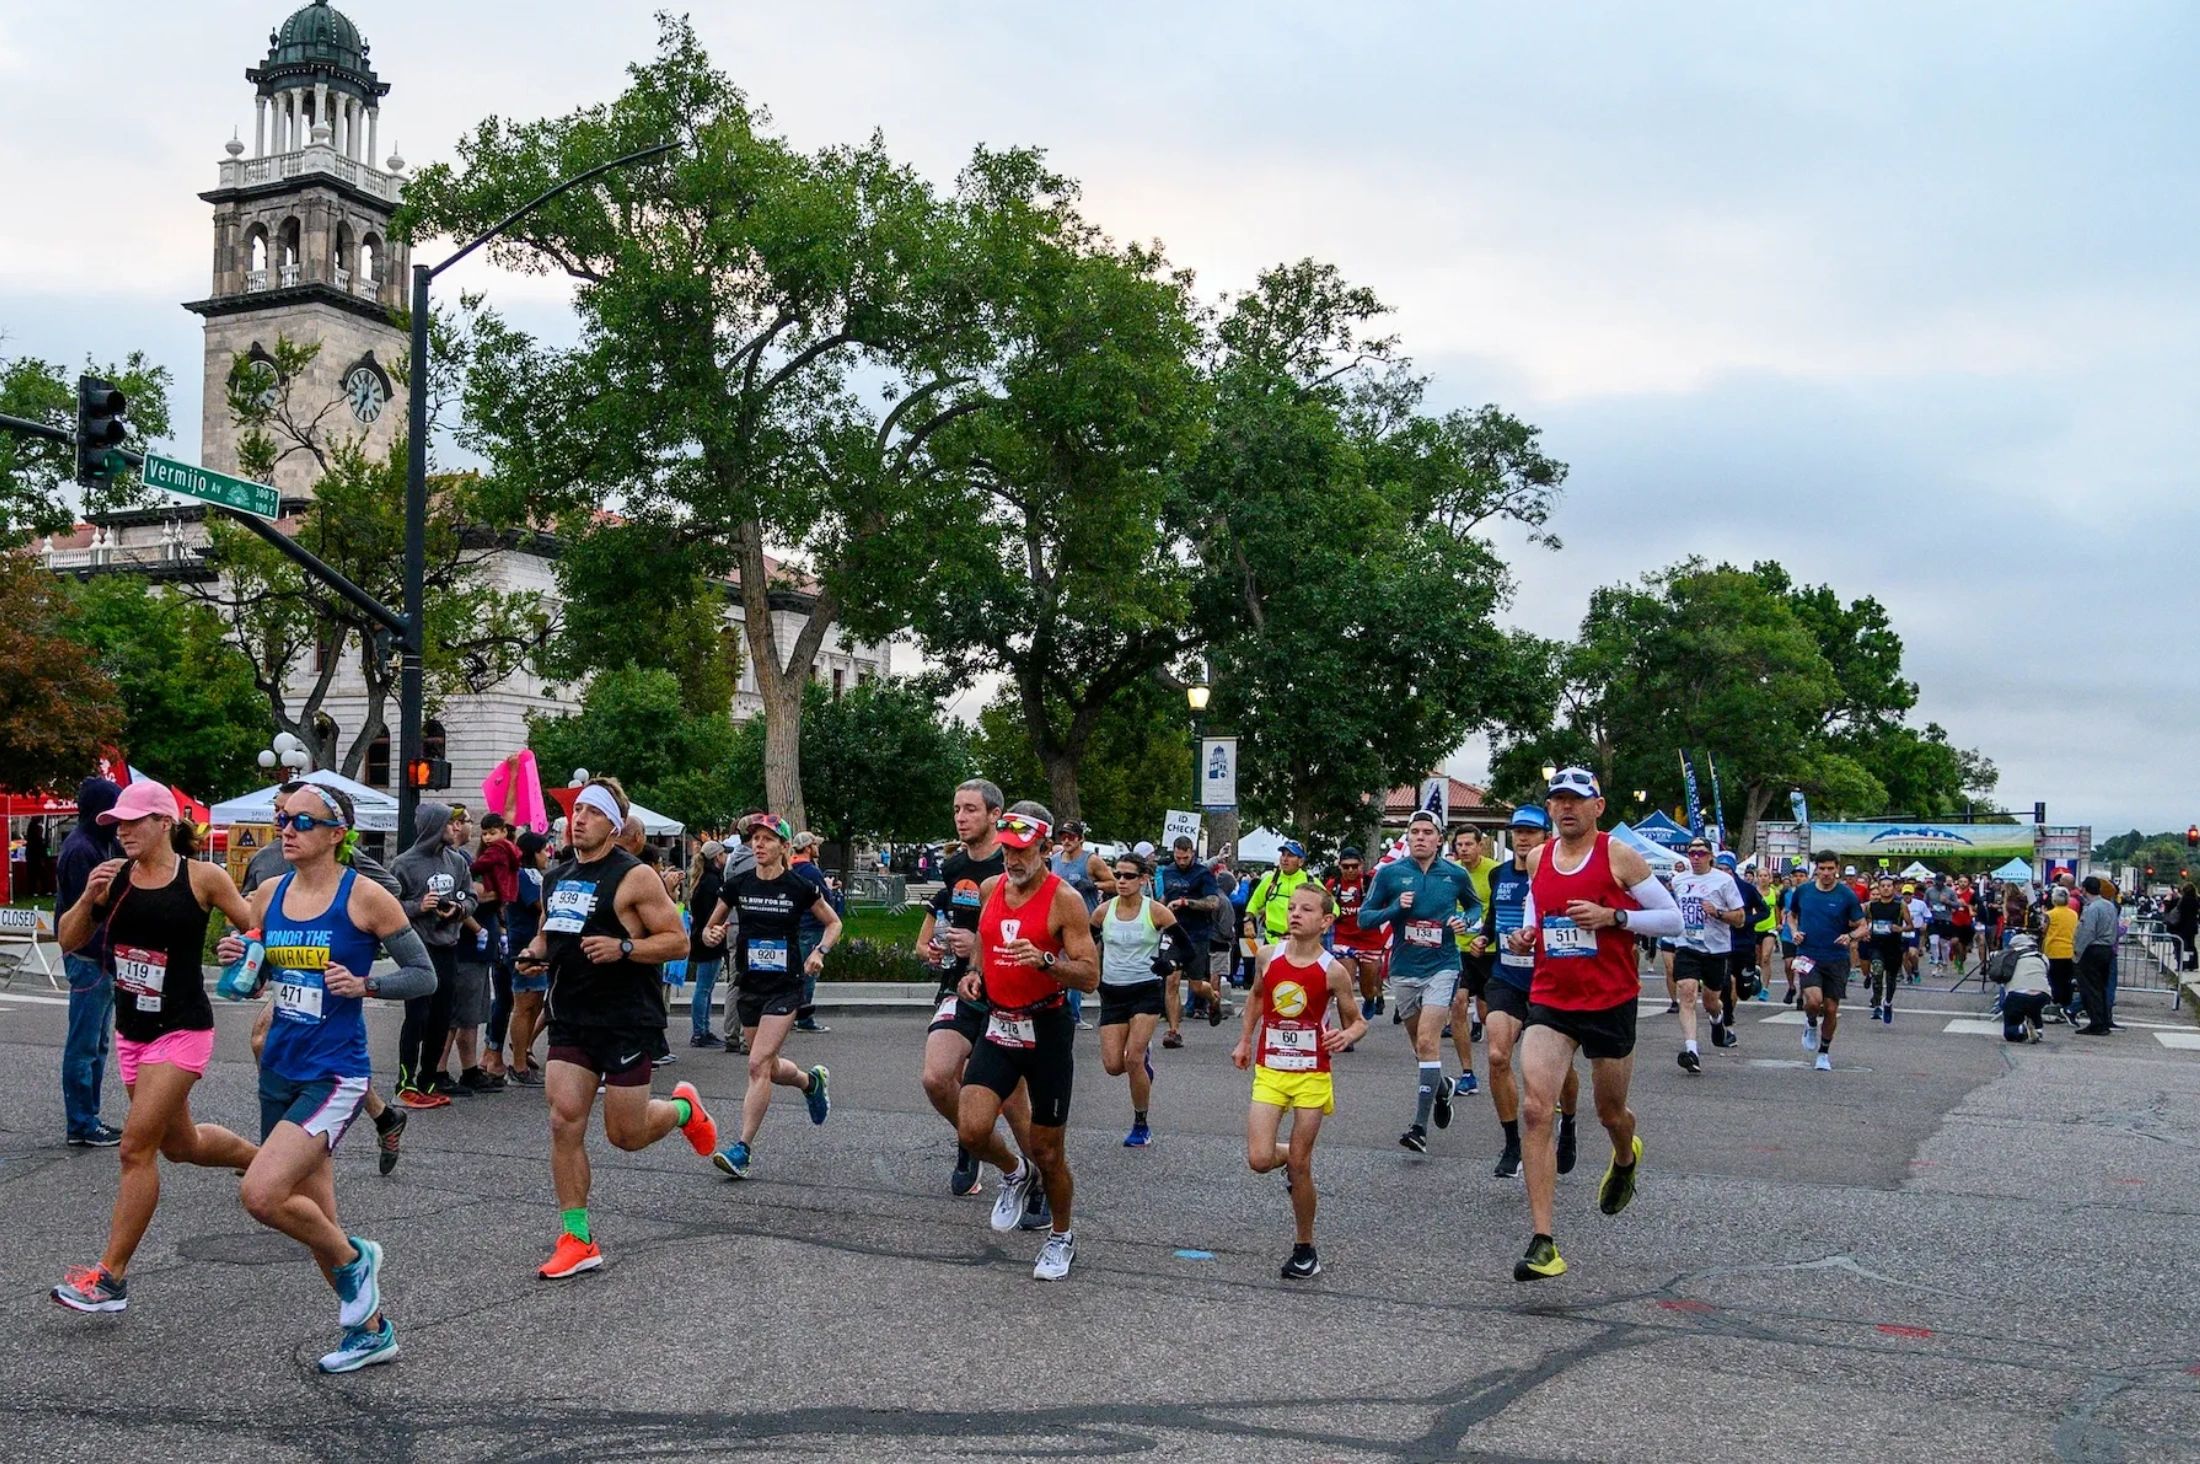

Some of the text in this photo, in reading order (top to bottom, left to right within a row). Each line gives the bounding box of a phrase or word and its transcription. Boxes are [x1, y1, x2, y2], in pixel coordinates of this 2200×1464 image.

[149, 459, 207, 494] Vermijo
[270, 491, 276, 502] S
[255, 502, 274, 516] 100 E
[1178, 815, 1188, 823] ID
[1167, 824, 1196, 835] CHECK
[1887, 848, 1954, 856] MARATHON
[558, 892, 579, 905] 939
[1682, 905, 1704, 914] FOR
[2, 910, 37, 926] CLOSED
[305, 930, 333, 947] THE
[1415, 928, 1432, 938] 133
[1555, 929, 1578, 942] 511
[268, 949, 326, 967] OURNEY
[757, 949, 776, 960] 920
[127, 962, 149, 979] 119
[280, 985, 302, 1003] 471
[1282, 1031, 1298, 1043] 60
